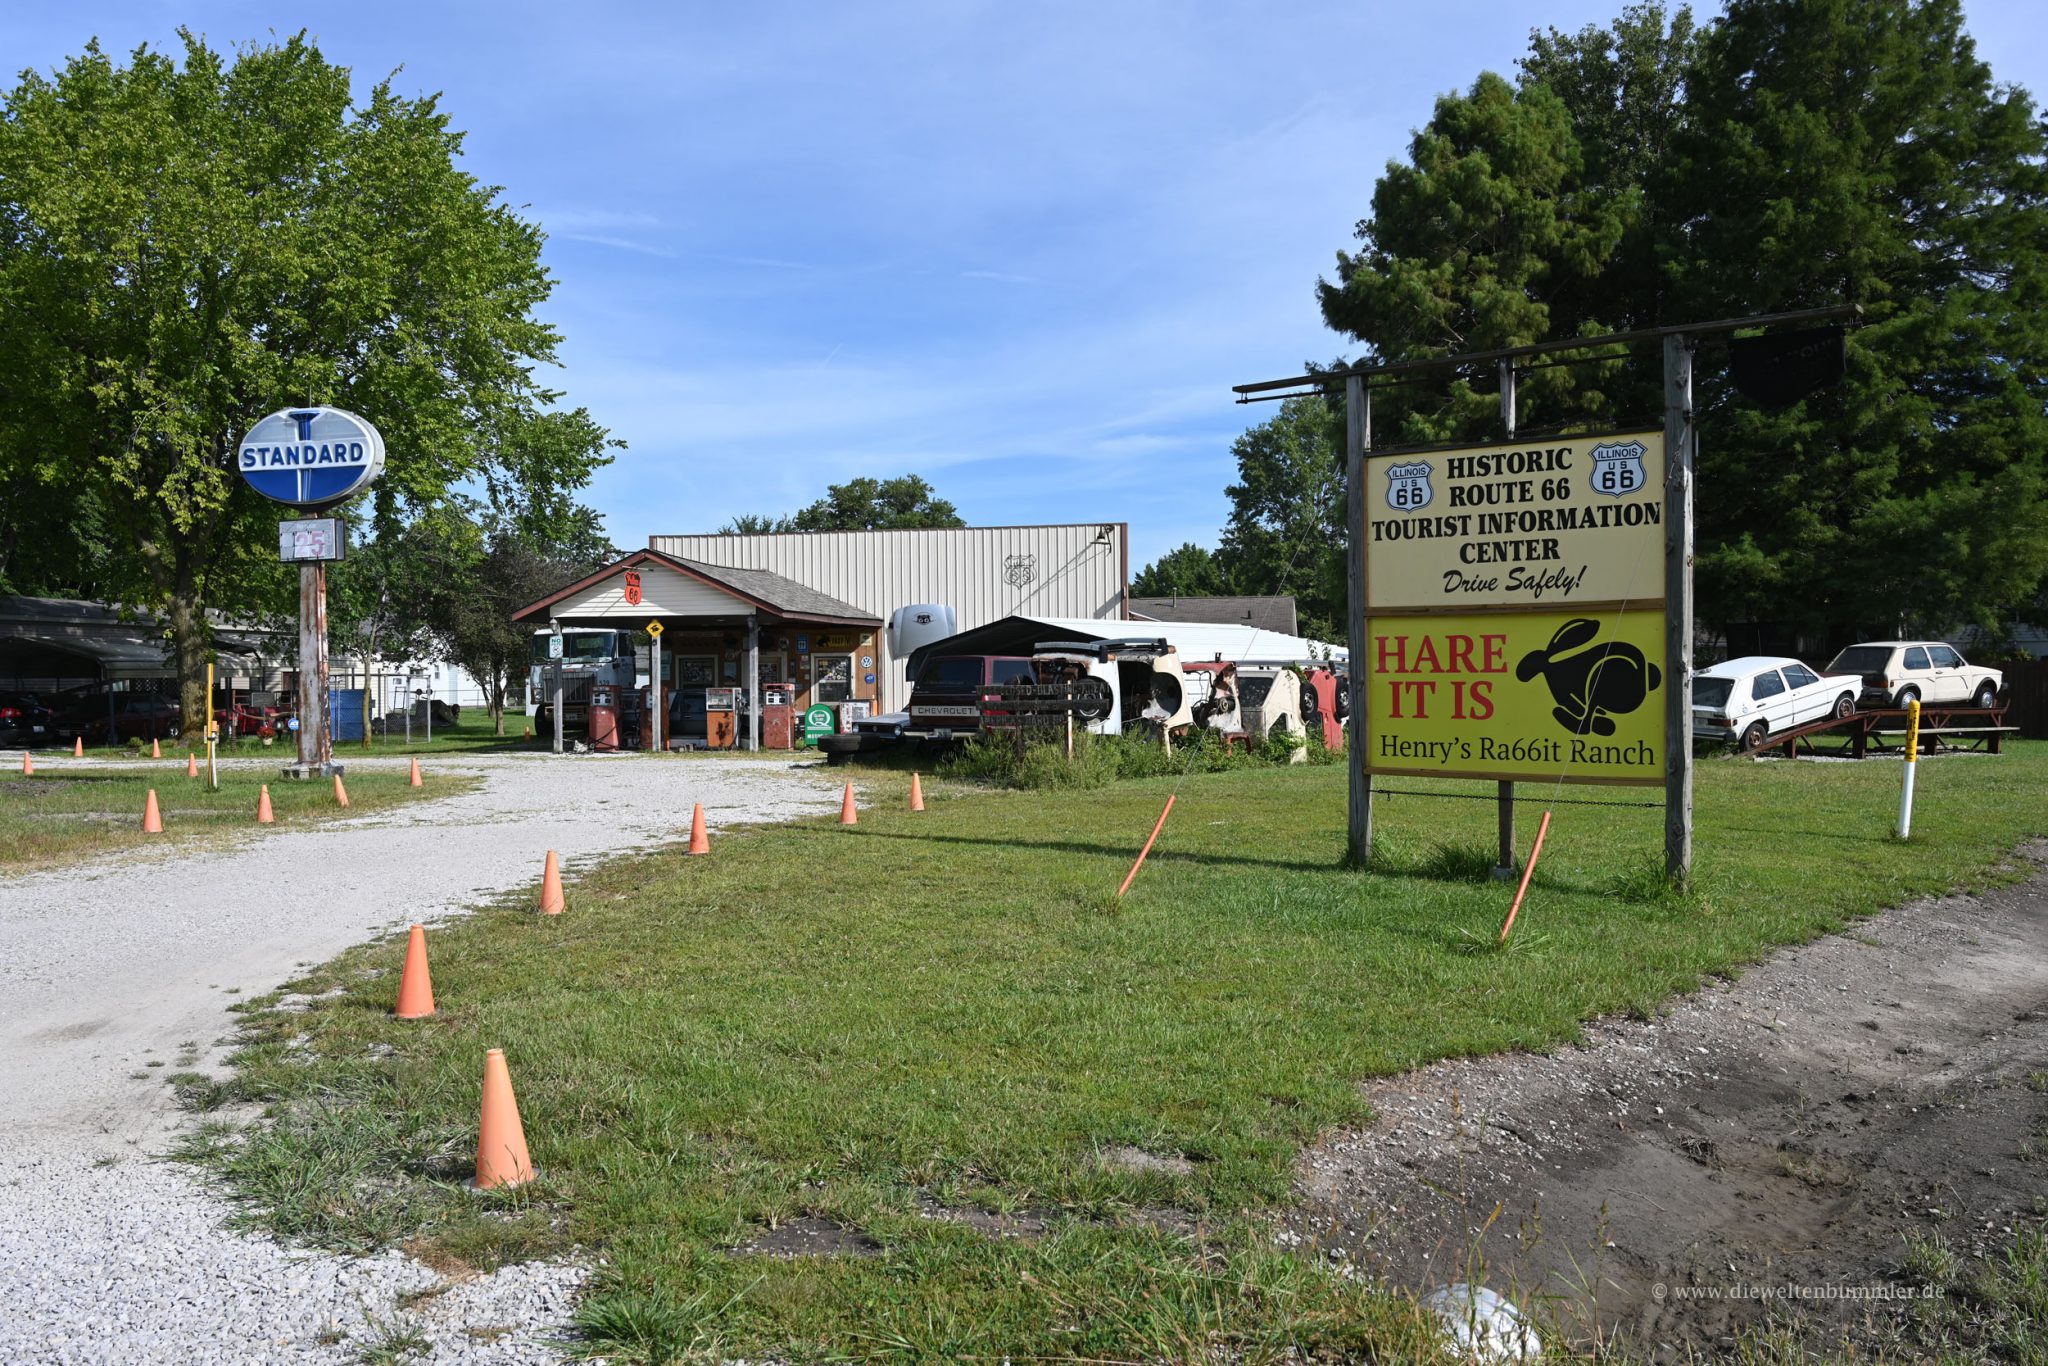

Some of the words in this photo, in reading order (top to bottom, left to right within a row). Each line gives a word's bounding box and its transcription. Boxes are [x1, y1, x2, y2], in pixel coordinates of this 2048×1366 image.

[243, 442, 364, 468] STANDARD
[1446, 447, 1573, 479] HISTORIC
[1597, 447, 1638, 459] ILLINOIS
[1608, 461, 1628, 470] US
[1392, 466, 1427, 477] ILLINOIS
[1401, 479, 1418, 488] US
[1602, 470, 1634, 490] 66
[1396, 488, 1423, 506] 66
[1449, 480, 1534, 507] ROUTE
[1541, 477, 1571, 501] 66
[1372, 514, 1472, 541] TOURIST
[1478, 501, 1661, 535] INFORMATION
[1459, 538, 1560, 564] CENTER
[629, 587, 639, 603] 66
[1443, 569, 1498, 594] Drive
[1505, 565, 1588, 599] Safely!
[1374, 633, 1508, 674] HARE
[1388, 681, 1436, 719] IT
[1450, 680, 1494, 720] IS
[1380, 734, 1471, 764] Henry's
[1480, 736, 1561, 763] Ra66it
[1569, 739, 1655, 766] Ranch
